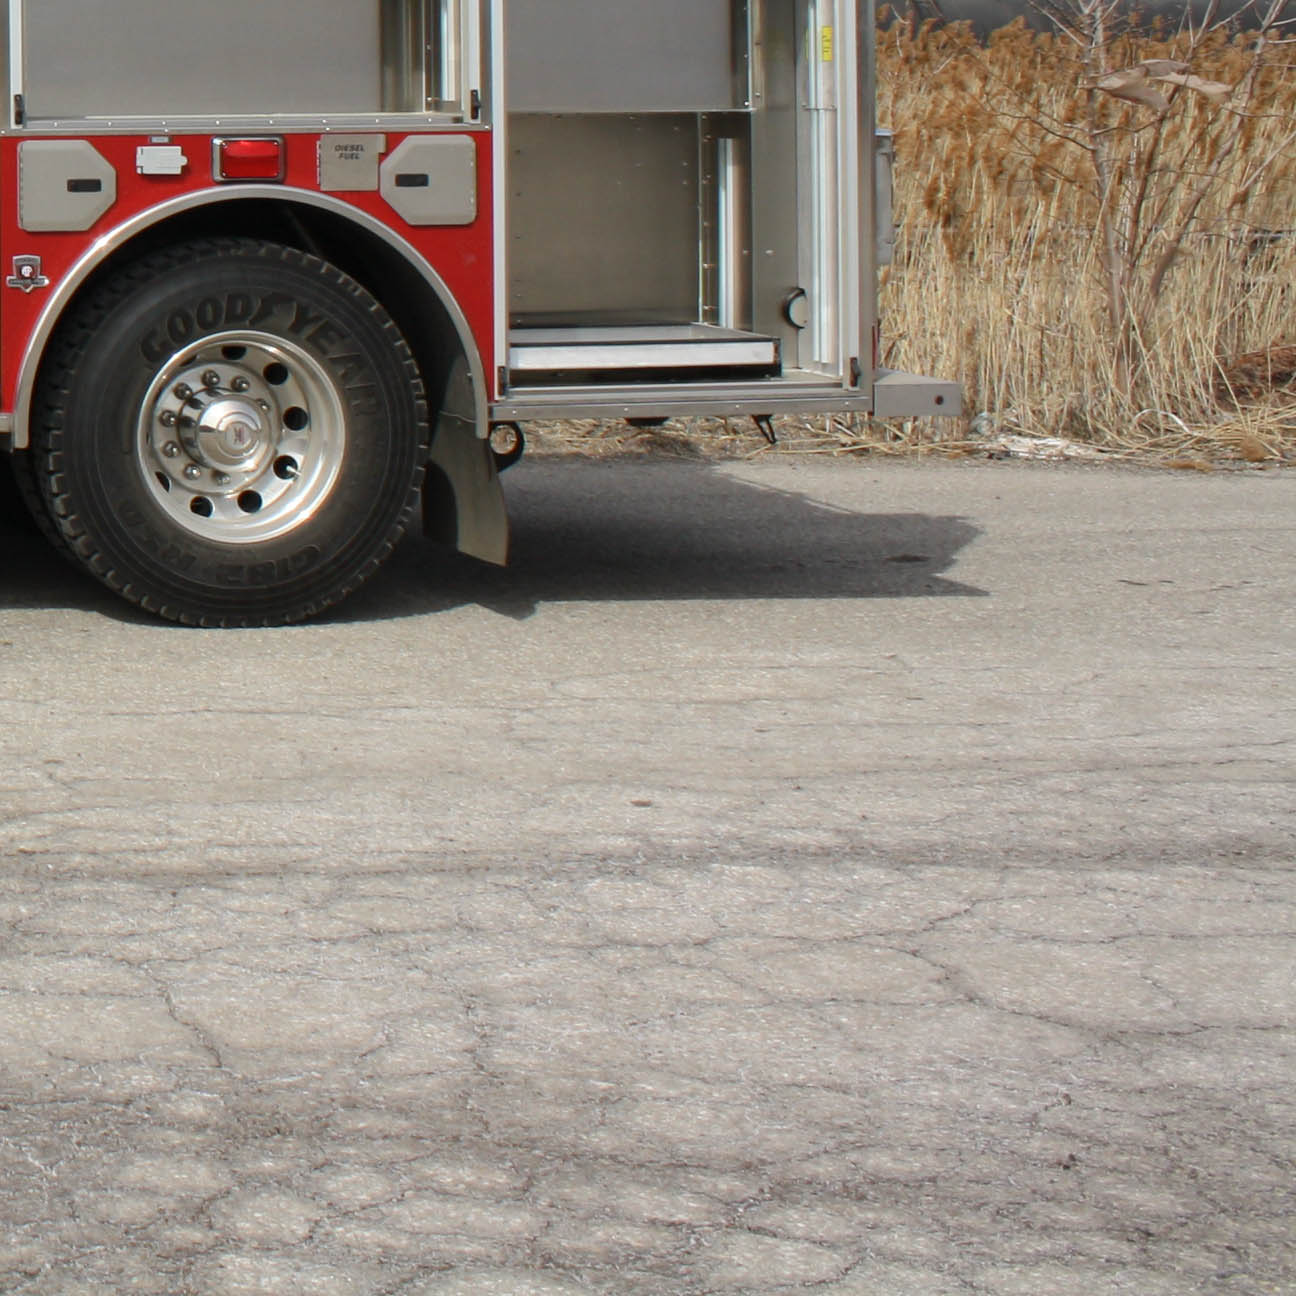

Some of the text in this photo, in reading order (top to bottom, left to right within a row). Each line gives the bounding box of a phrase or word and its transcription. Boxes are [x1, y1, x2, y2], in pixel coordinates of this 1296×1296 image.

[334, 144, 365, 152] DIESEL
[338, 152, 360, 160] FUEL
[138, 291, 377, 416] GOODYEAR
